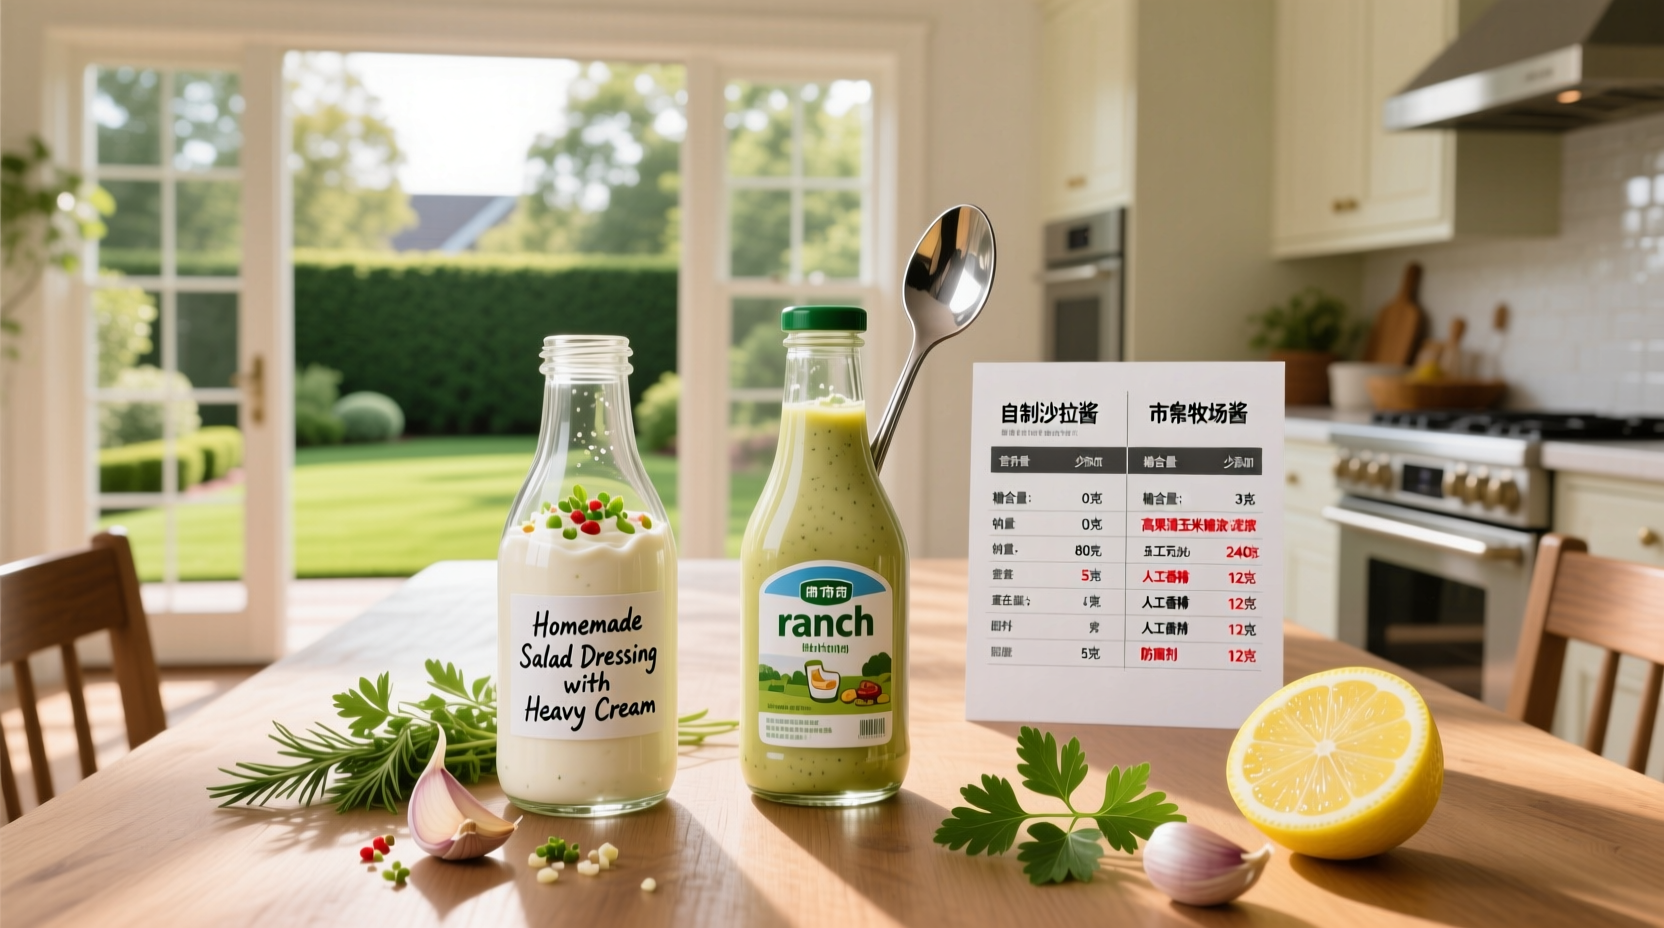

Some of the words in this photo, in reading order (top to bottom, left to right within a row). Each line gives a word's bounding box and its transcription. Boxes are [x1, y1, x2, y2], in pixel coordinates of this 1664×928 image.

[1002, 401, 1098, 424] 自制沙拉酱
[1082, 491, 1103, 504] 0克
[1235, 492, 1256, 506] 3克
[1082, 517, 1103, 530] 0克
[1228, 570, 1256, 585] 12克
[1228, 596, 1257, 610] 12克
[533, 606, 643, 638] Homemade
[778, 605, 874, 638] ranch
[1228, 622, 1257, 636] 12克
[519, 642, 574, 669] Salad
[580, 643, 657, 674] Dressing
[1228, 648, 1256, 663] 12克
[563, 670, 610, 694] with
[525, 695, 586, 732] Heavy
[594, 696, 656, 722] Cream
